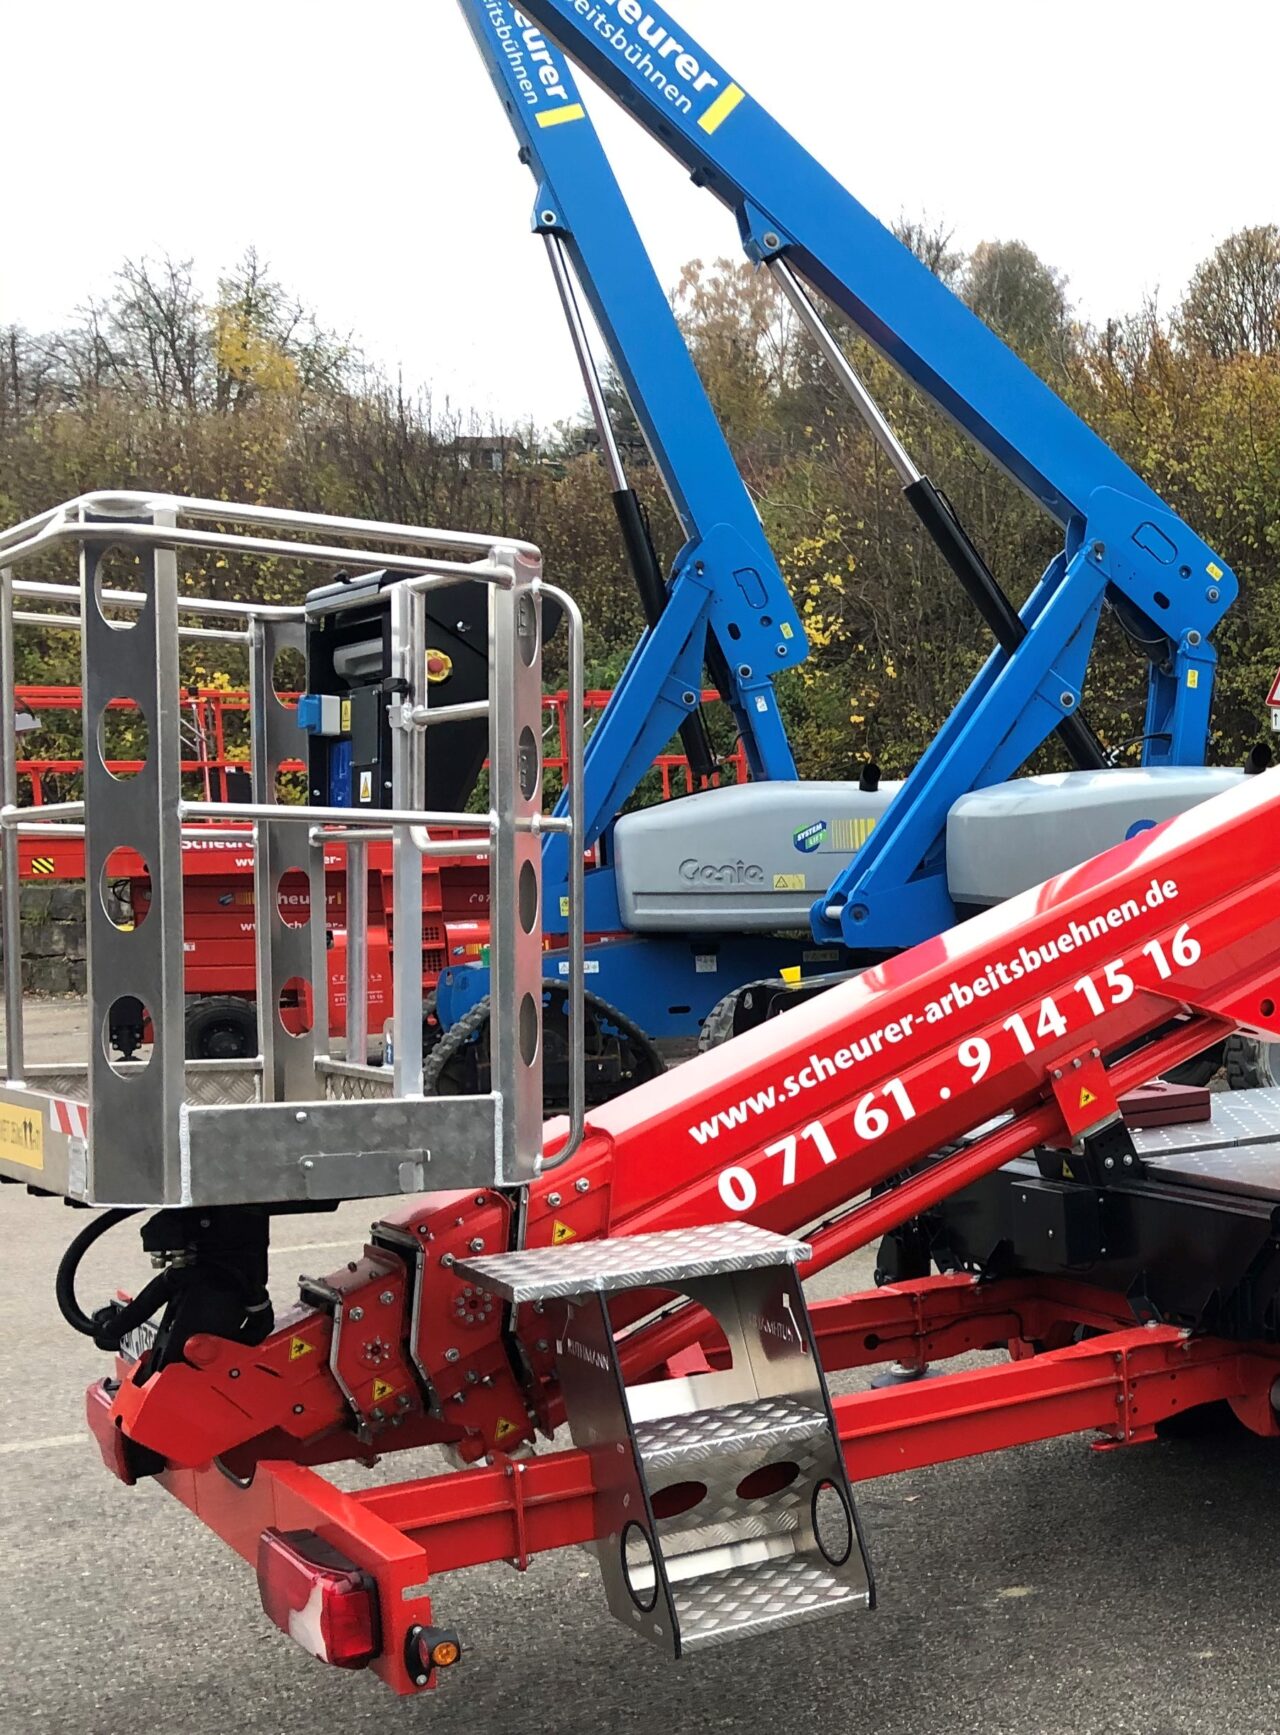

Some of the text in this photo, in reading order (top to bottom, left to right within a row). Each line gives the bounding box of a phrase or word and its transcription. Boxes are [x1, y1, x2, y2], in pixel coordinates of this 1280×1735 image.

[604, 0, 719, 92] eurer
[679, 858, 764, 885] Genie
[797, 822, 823, 841] SYSTEM
[688, 879, 1179, 1145] www.scheurer-arbeitsbuehnen.de
[717, 1165, 757, 1212] 0
[764, 1120, 837, 1186] 71
[853, 1077, 917, 1141] 61
[957, 1037, 991, 1085] 9
[1002, 996, 1067, 1056] 14
[1073, 958, 1135, 1016] 15
[1142, 923, 1201, 981] 16
